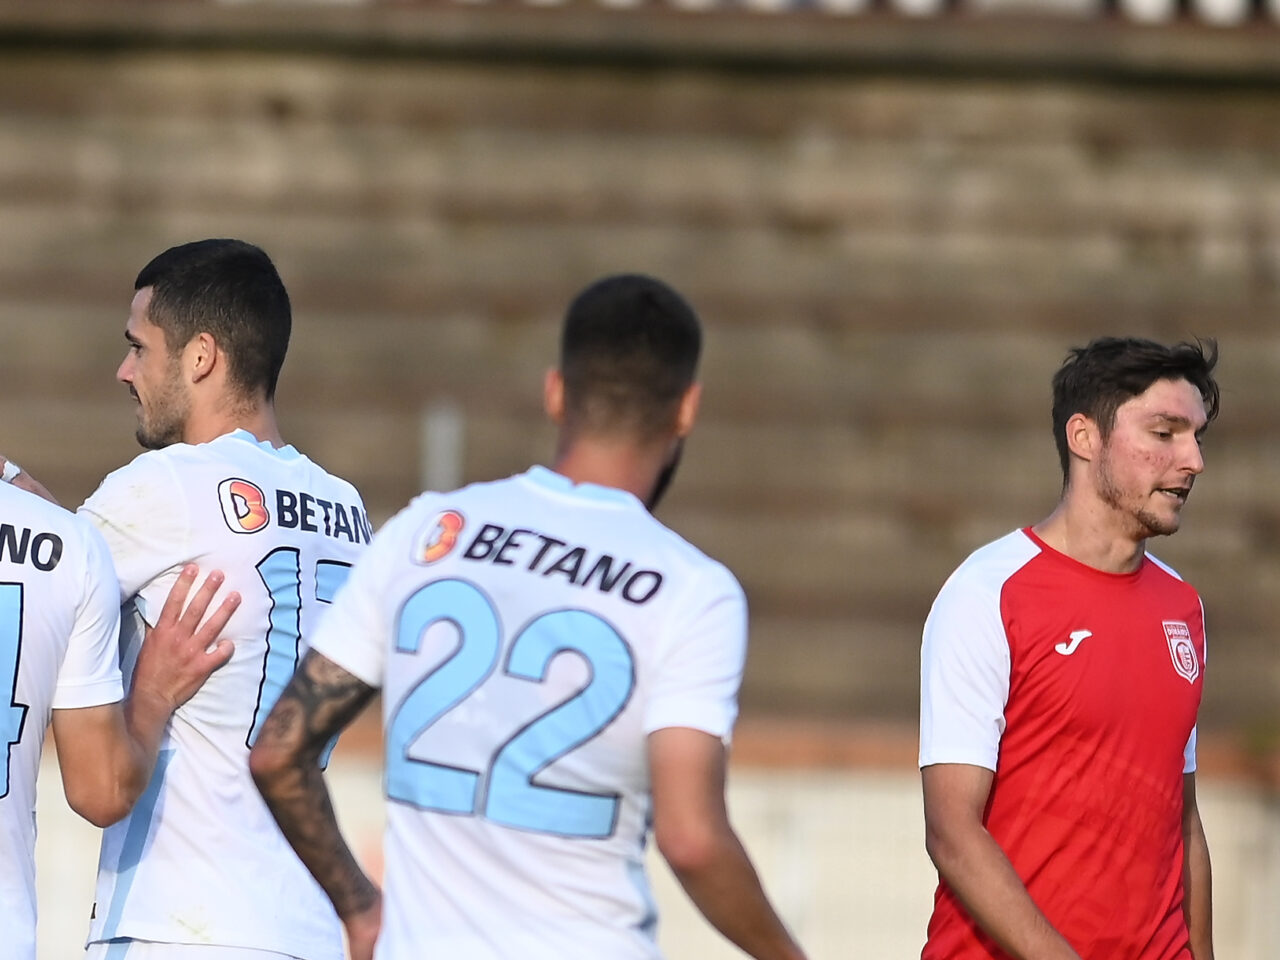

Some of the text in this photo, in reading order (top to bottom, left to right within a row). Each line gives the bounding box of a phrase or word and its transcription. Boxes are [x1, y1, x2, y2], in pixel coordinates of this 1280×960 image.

[275, 489, 373, 545] BETAN
[463, 523, 663, 605] BETANO
[385, 576, 637, 840] 22
